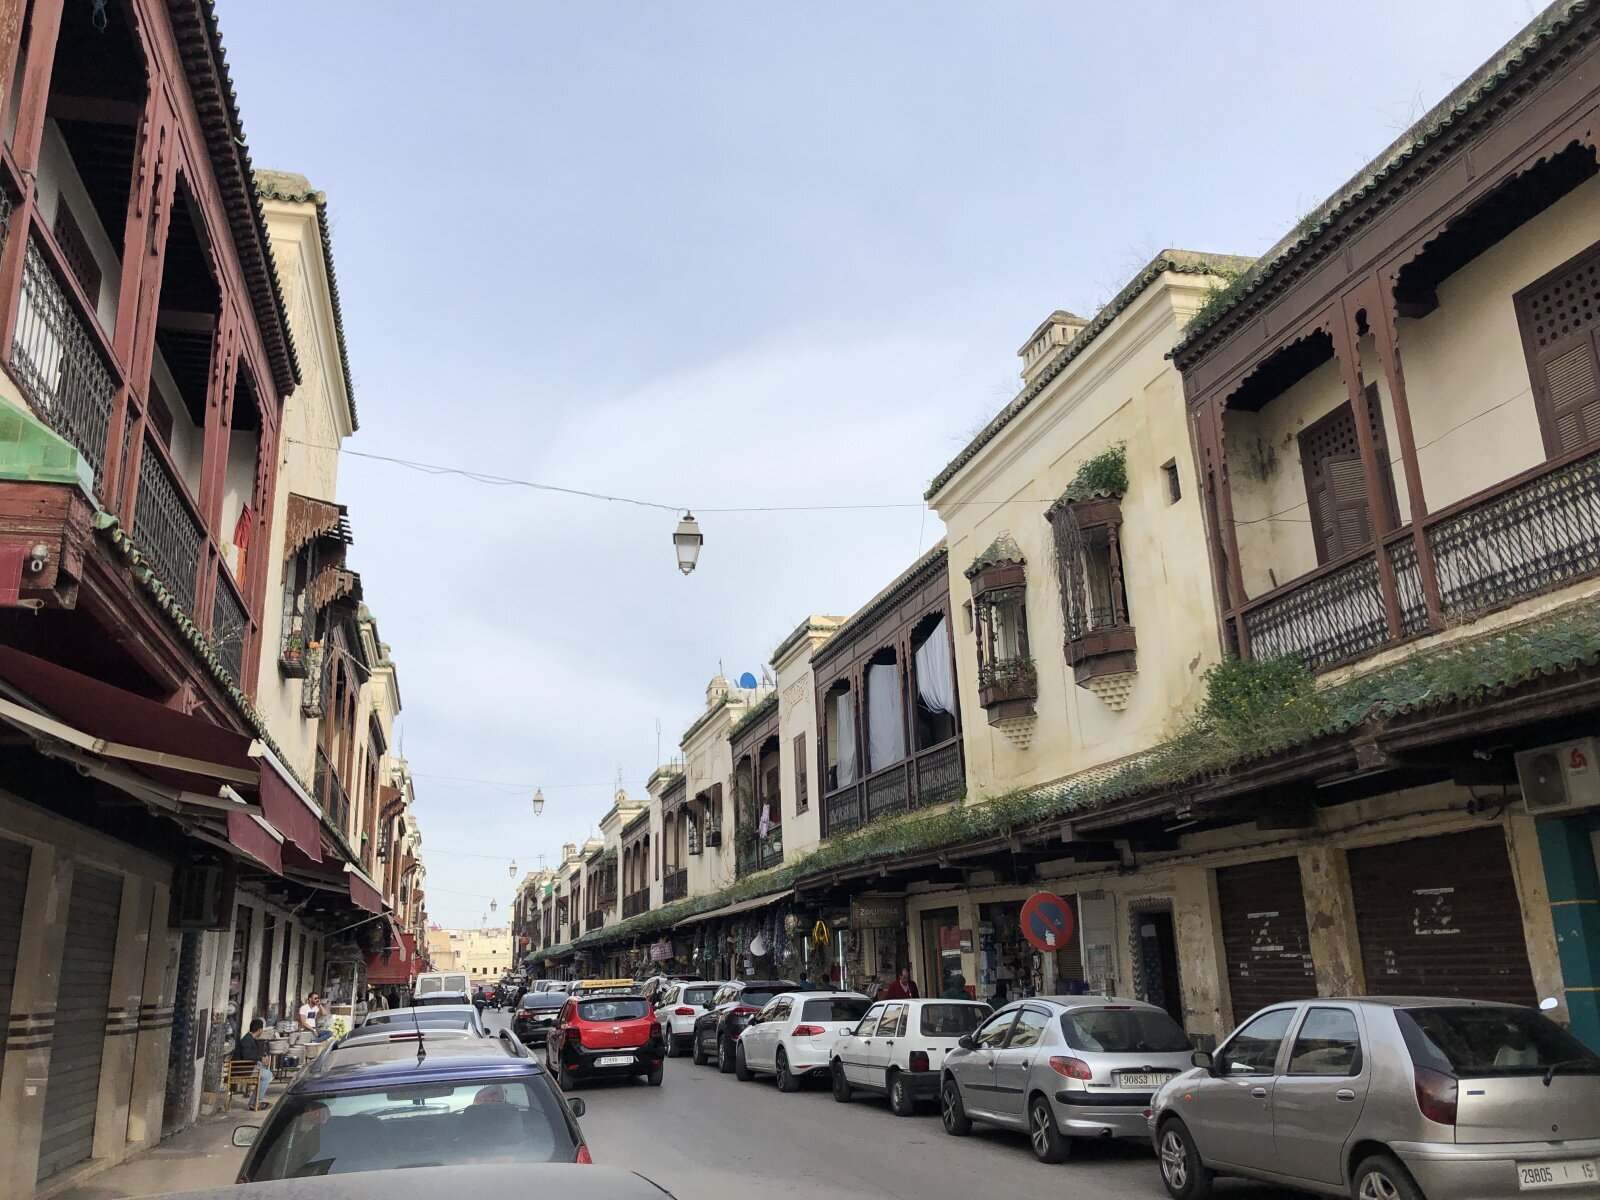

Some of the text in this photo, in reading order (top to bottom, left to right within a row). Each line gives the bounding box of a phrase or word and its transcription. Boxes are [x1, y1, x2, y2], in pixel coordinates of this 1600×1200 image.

[1123, 1074, 1148, 1085] 90853
[1521, 1167, 1553, 1183] 29805
[1581, 1163, 1594, 1178] 15
